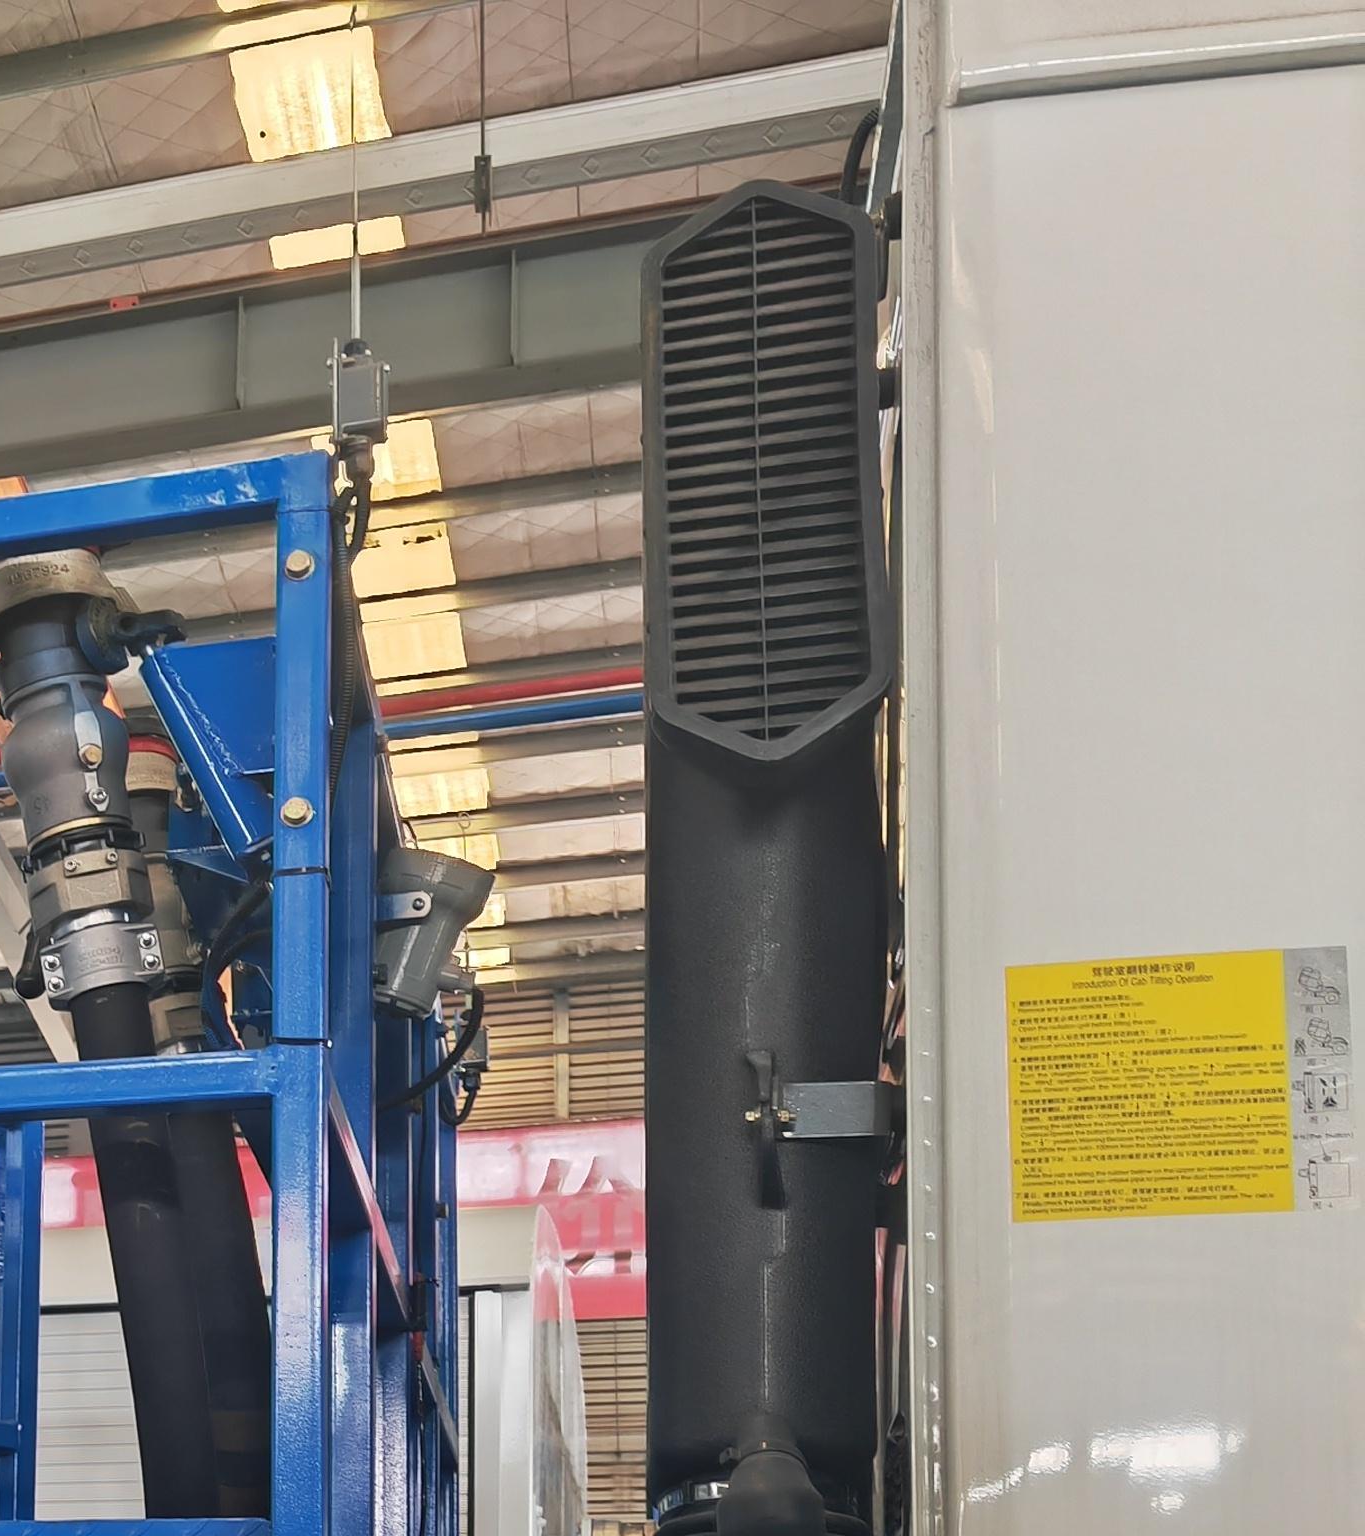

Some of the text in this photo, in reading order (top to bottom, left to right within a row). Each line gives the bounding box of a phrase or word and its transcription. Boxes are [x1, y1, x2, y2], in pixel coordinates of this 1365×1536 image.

[1072, 979, 1117, 989] Introduction
[1131, 976, 1148, 986] Cab
[1175, 973, 1214, 984] Operation
